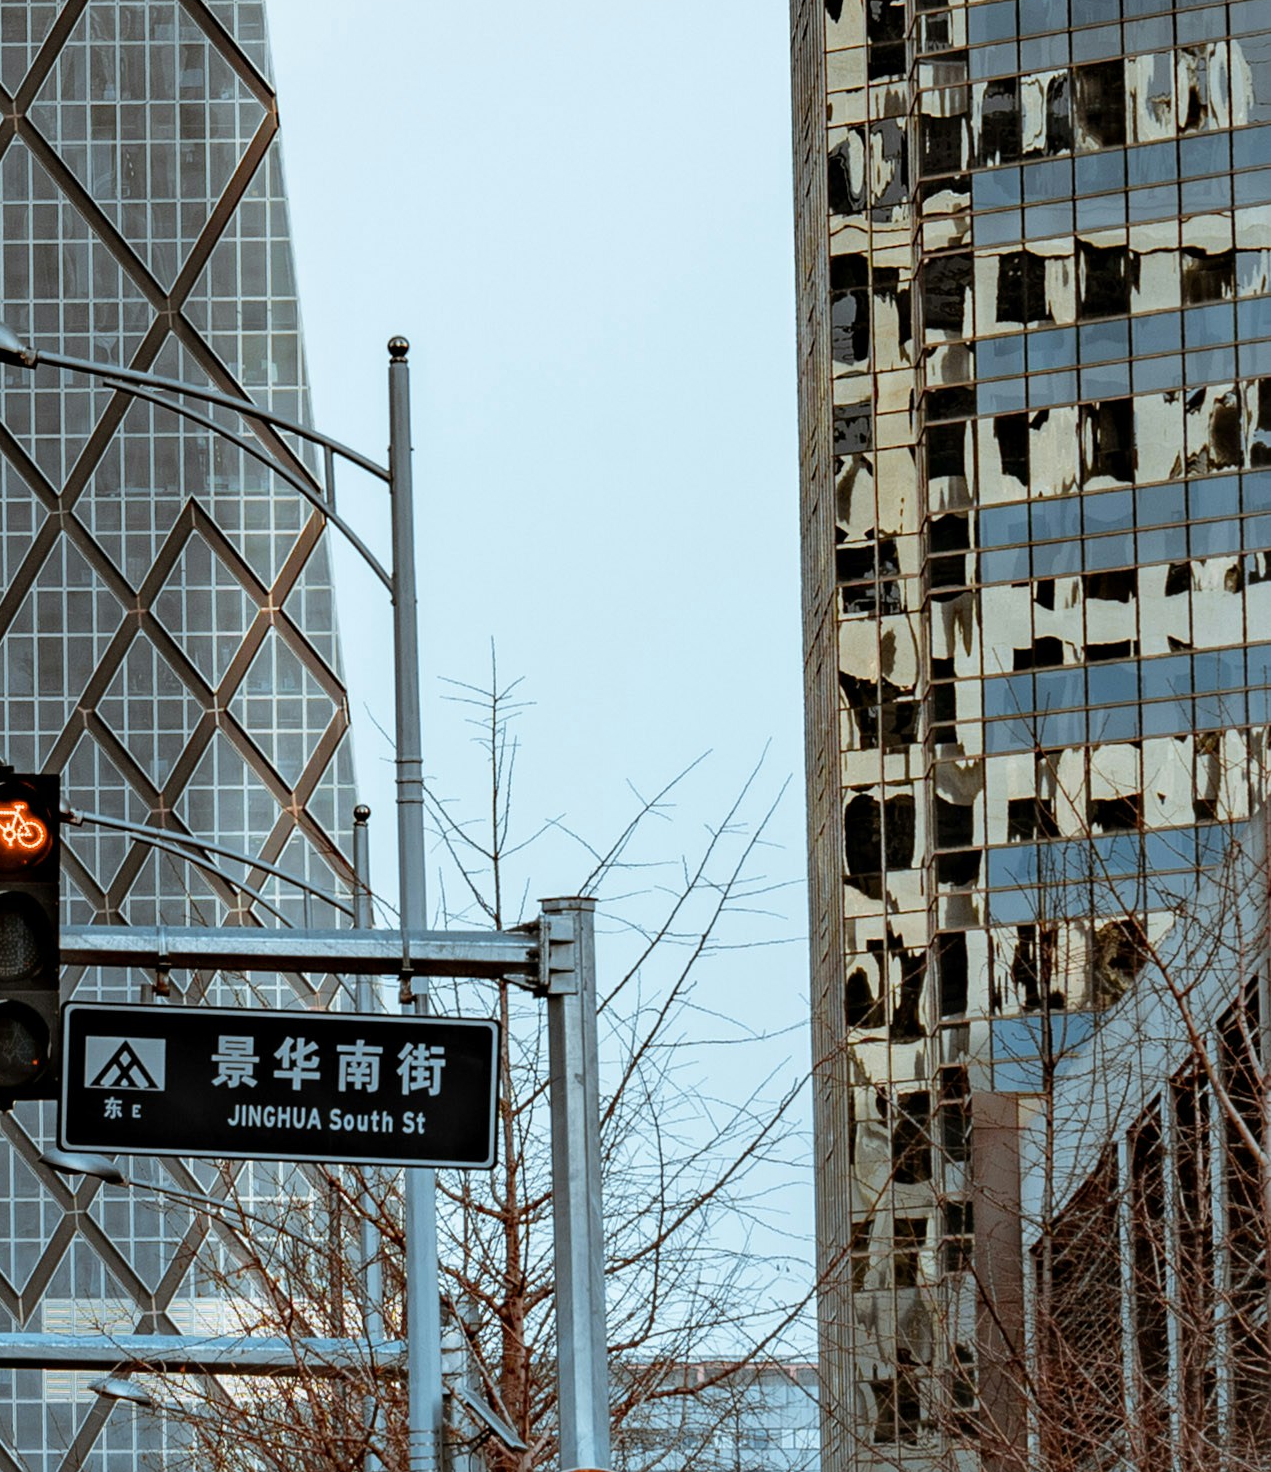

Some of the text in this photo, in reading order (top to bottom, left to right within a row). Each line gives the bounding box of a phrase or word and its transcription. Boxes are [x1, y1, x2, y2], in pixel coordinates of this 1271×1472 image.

[210, 1034, 447, 1097] 景华南街
[103, 1096, 142, 1120] 东 E
[227, 1104, 426, 1135] JINGHUA South St
